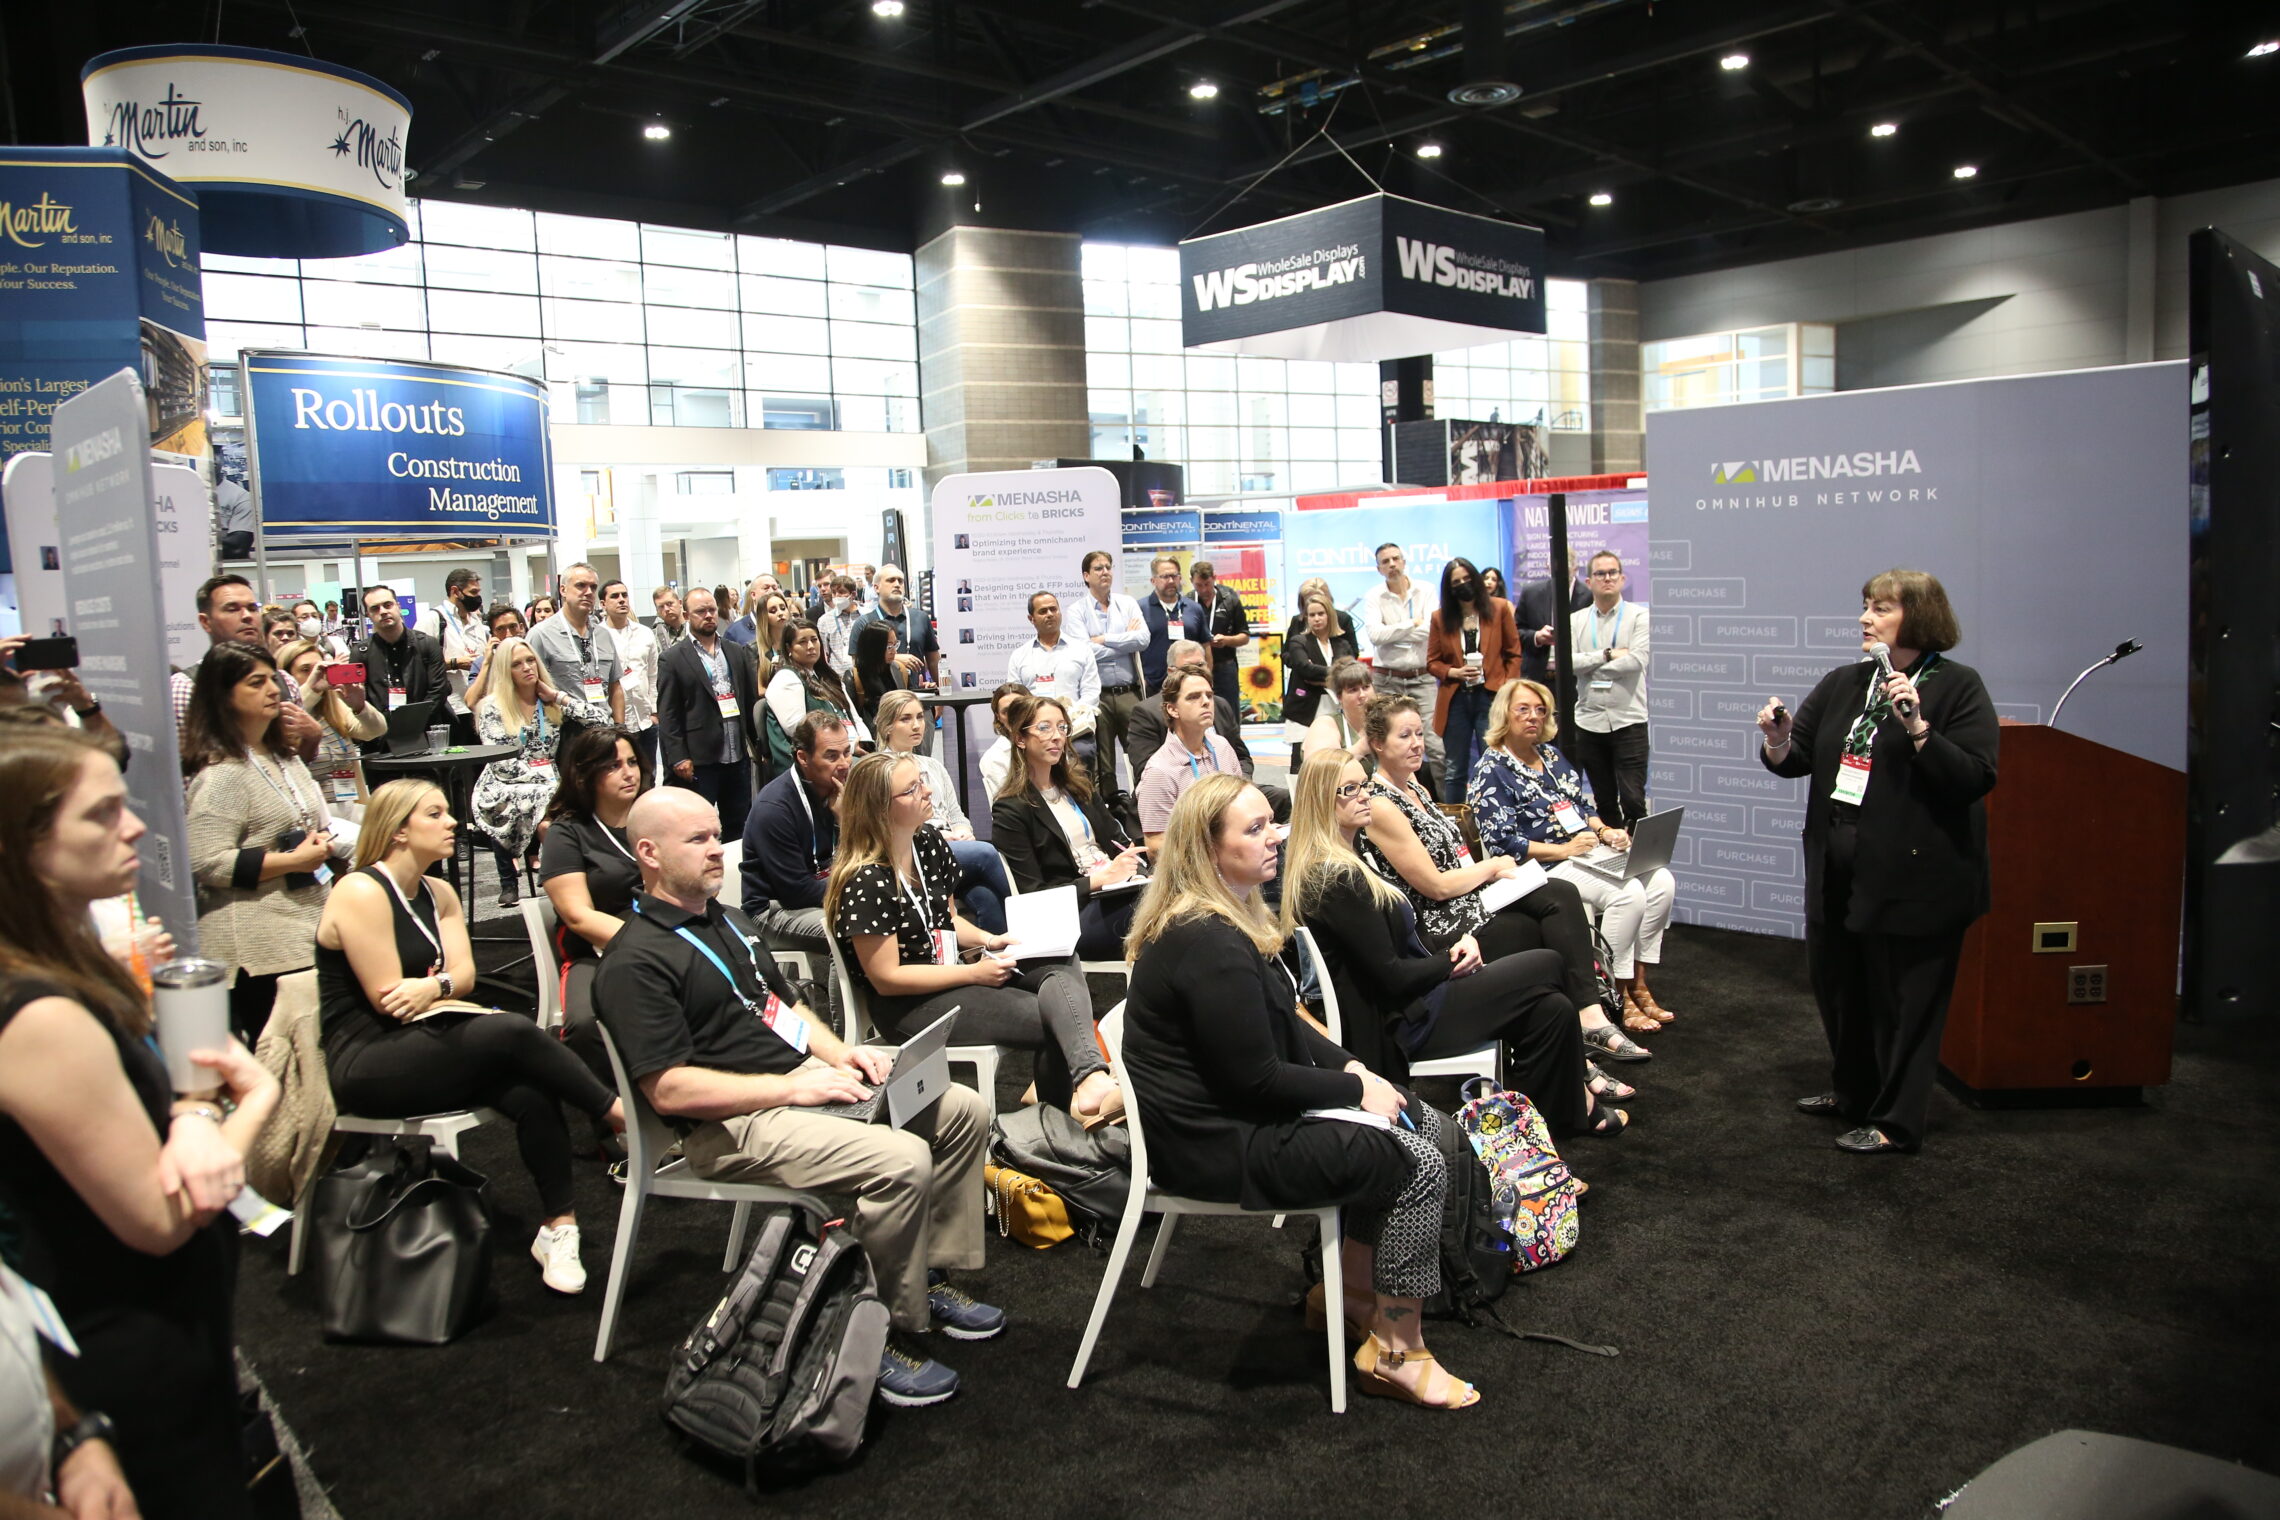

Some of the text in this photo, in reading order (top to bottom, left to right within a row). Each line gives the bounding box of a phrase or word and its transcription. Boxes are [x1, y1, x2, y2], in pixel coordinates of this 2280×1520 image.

[110, 82, 208, 159] Martin
[188, 139, 248, 153] and son, inc
[61, 233, 112, 244] and son, inc
[1257, 242, 1359, 276] WholeSale Displays
[1396, 235, 1456, 287] WS
[0, 263, 119, 276] ple. Our Reputation.
[27, 279, 78, 290] Success.
[1258, 257, 1360, 302] DISPLAY
[1456, 265, 1531, 300] DISPLAY
[1193, 263, 1259, 312] WS
[0, 378, 89, 396] ion's Largest
[0, 399, 64, 416] elf-Perf
[291, 388, 465, 437] Rollouts
[0, 421, 52, 434] rior Con
[3, 440, 52, 453] Speciali
[388, 452, 521, 484] Construction
[1763, 449, 1922, 482] MENASHA
[428, 487, 539, 521] Management
[997, 490, 1082, 507] MENASHA
[1696, 488, 1938, 510] OMNIHUB NETWORK
[968, 512, 992, 523] from
[995, 511, 1025, 522] Clicks
[1042, 507, 1085, 519] BRICKS
[1525, 503, 1609, 528] NATNWIDE
[156, 520, 178, 533] CKS
[972, 535, 1086, 549] Optimizing the omnichannel
[972, 547, 1042, 558] brand experience
[1296, 541, 1455, 567] CONTINNTAL
[974, 583, 1014, 593] Designing
[1047, 581, 1063, 589] FFP
[1065, 580, 1087, 588] solut
[1222, 578, 1259, 592] WAKE
[974, 593, 991, 601] that
[1010, 592, 1017, 600] in
[1054, 590, 1085, 600] etplace
[1668, 588, 1727, 598] PURCHASE
[1244, 609, 1276, 622] FFEE
[977, 633, 1005, 642] Driving
[1717, 626, 1777, 637] PURCHASE
[1825, 627, 1861, 638] PURC
[977, 642, 1023, 650] with DataG
[1669, 662, 1727, 673] PURCHASE
[1717, 702, 1763, 713] PURCHA
[1670, 736, 1728, 749] PURCHASE
[1717, 776, 1777, 790] PURCHASE
[1684, 810, 1727, 823] RCHASE
[1771, 818, 1805, 829] PURC
[1717, 850, 1776, 865] PURCHASE
[1676, 881, 1727, 896] URCHASE
[1770, 892, 1805, 905] PURC
